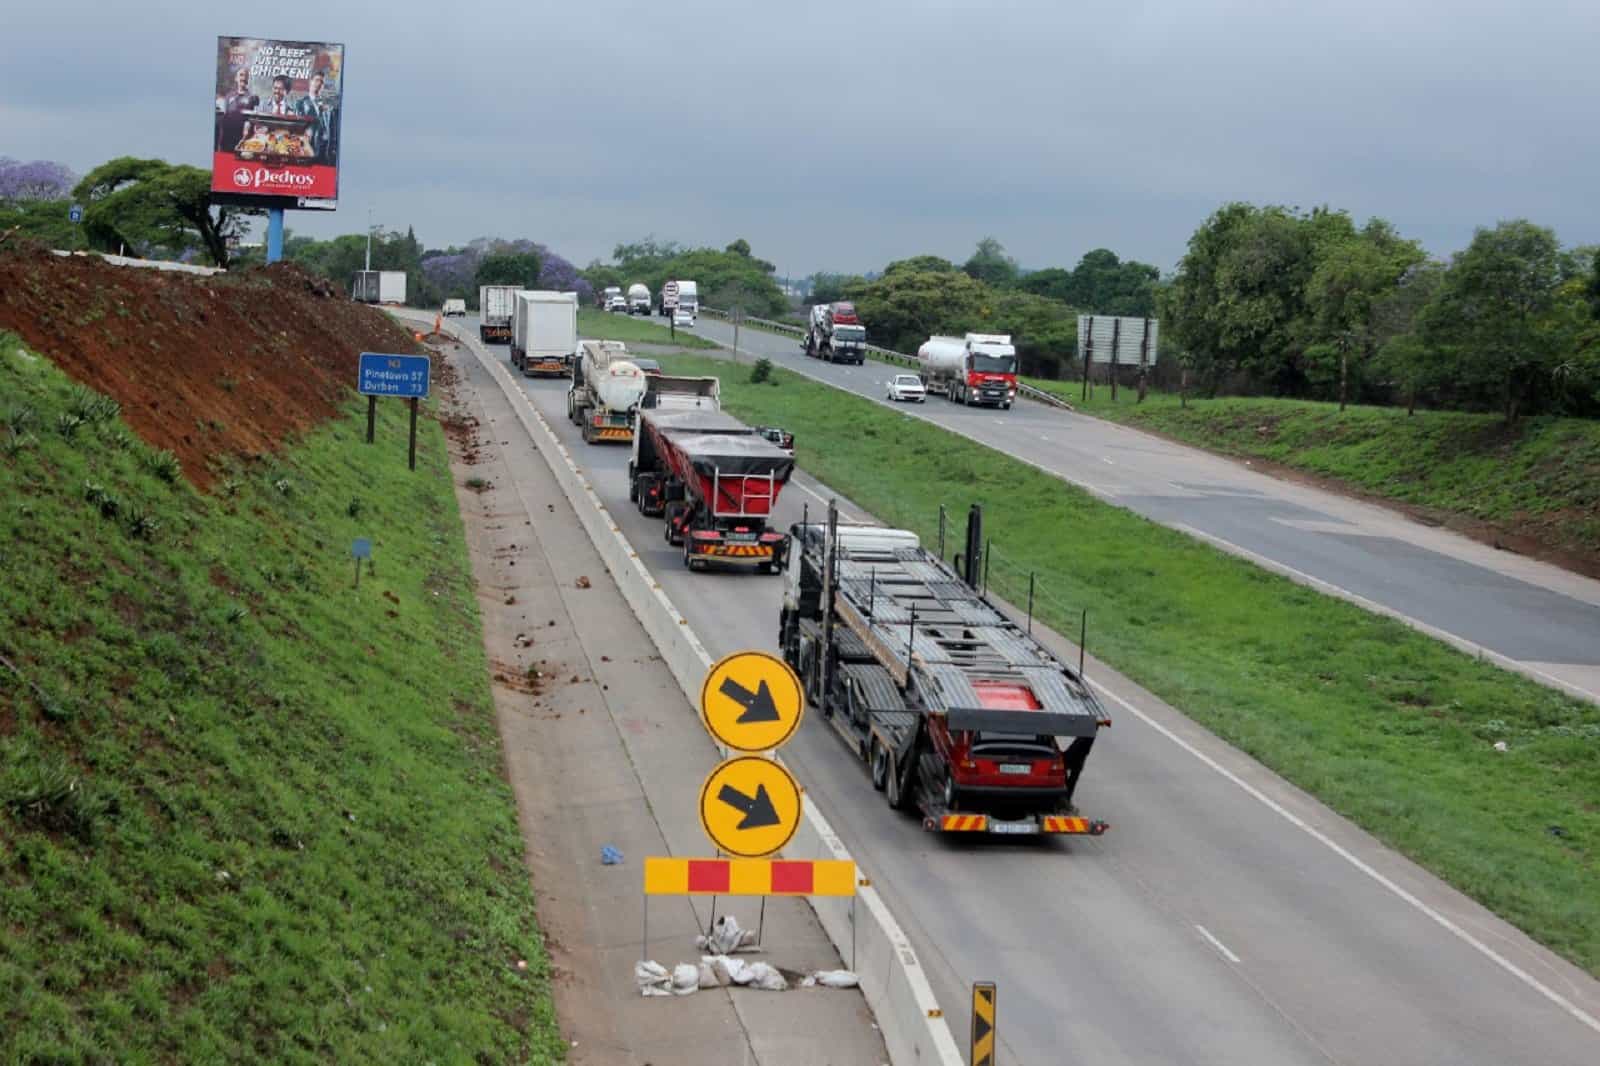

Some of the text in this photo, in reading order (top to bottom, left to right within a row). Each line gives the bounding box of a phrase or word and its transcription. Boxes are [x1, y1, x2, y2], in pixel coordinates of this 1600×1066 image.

[258, 46, 274, 56] NO
[255, 55, 311, 67] JUST GREAT
[254, 168, 315, 188] Pedros
[365, 369, 409, 381] Pinetown
[365, 380, 399, 392] Durban
